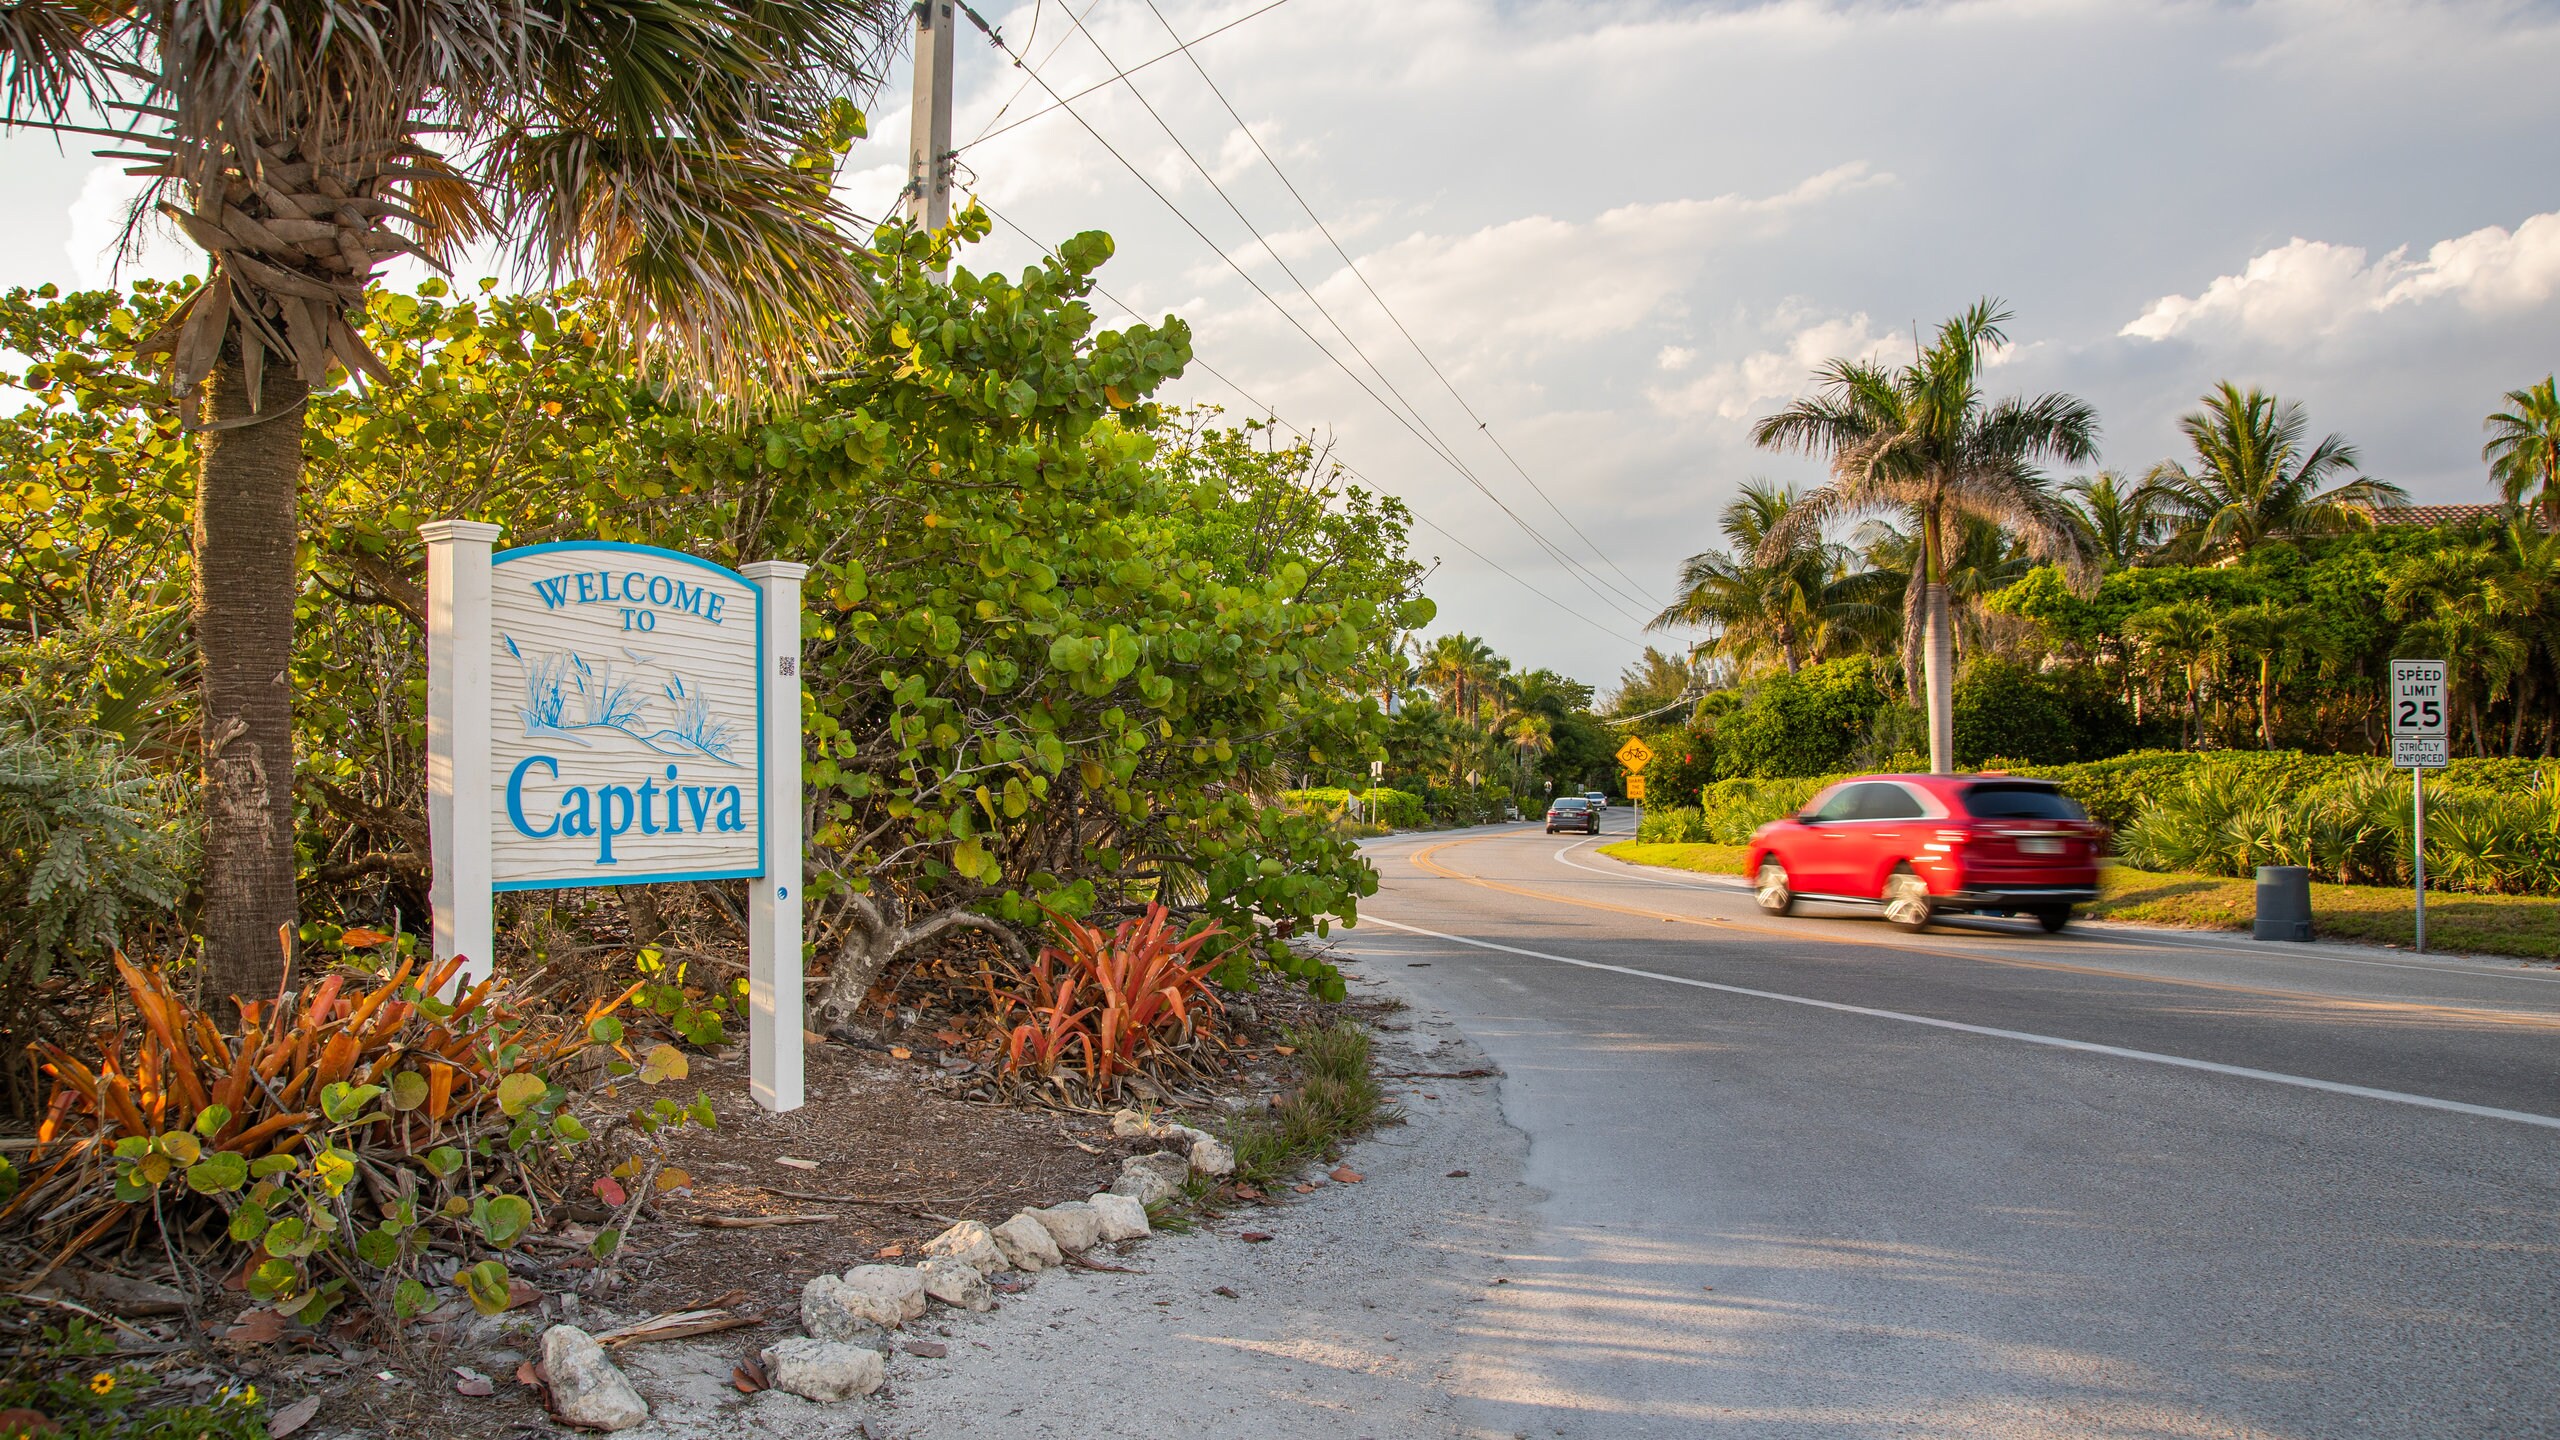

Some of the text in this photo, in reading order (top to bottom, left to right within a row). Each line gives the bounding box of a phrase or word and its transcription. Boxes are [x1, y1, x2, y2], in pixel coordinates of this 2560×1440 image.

[532, 571, 725, 625] WELCOME
[619, 608, 656, 632] TO
[2397, 670, 2441, 681] SPEED
[2402, 685, 2437, 696] LIMIT
[2398, 701, 2442, 727] 25
[2399, 743, 2439, 752] STRICTLY
[2398, 754, 2444, 763] ENFORCED
[506, 755, 746, 865] Captiva
